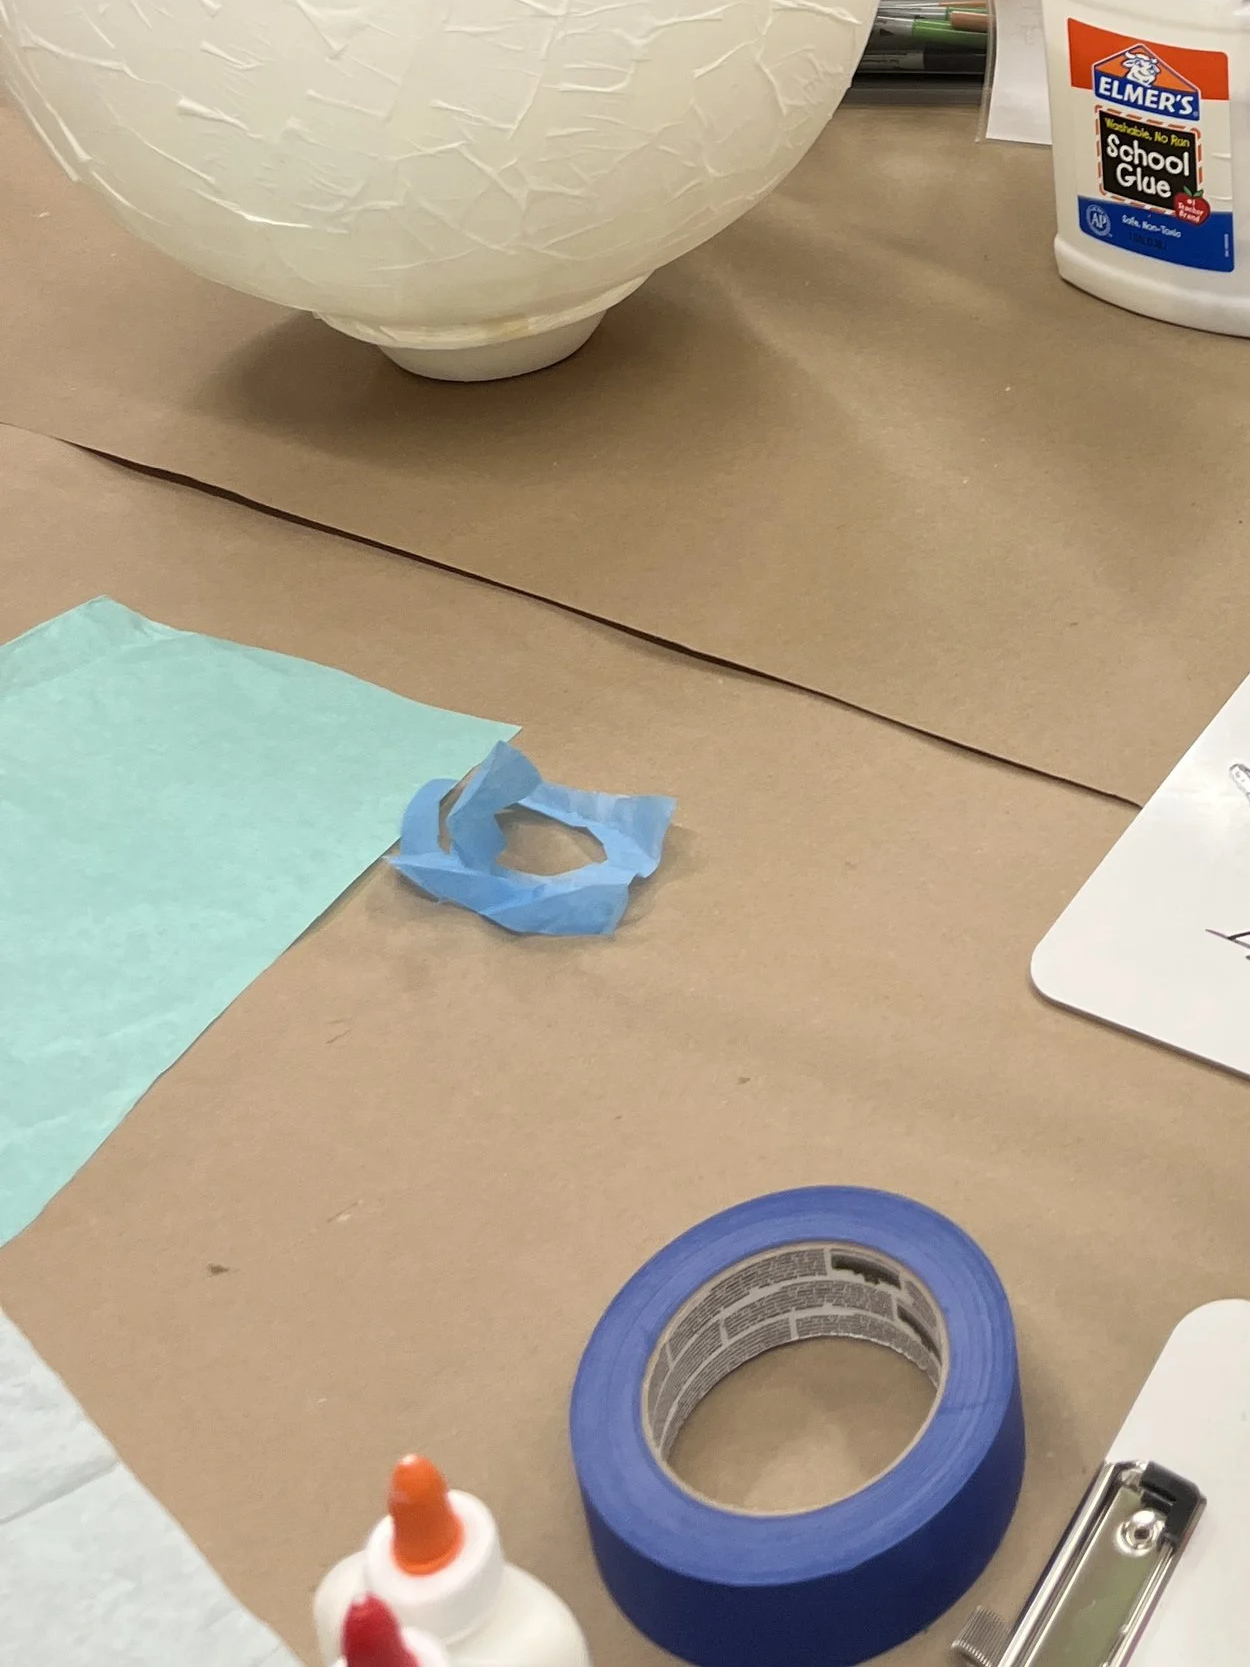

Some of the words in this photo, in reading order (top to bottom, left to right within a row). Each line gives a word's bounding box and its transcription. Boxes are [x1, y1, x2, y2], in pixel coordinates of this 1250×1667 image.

[1099, 76, 1194, 116] ELMER'S
[1154, 130, 1169, 144] No
[1170, 133, 1190, 148] Run
[1106, 133, 1190, 177] School
[1116, 163, 1172, 198] Glue
[1177, 202, 1204, 217] Teacher
[1179, 211, 1201, 224] Brand
[1090, 213, 1106, 229] AP
[1141, 220, 1182, 238] Non-Toxic
